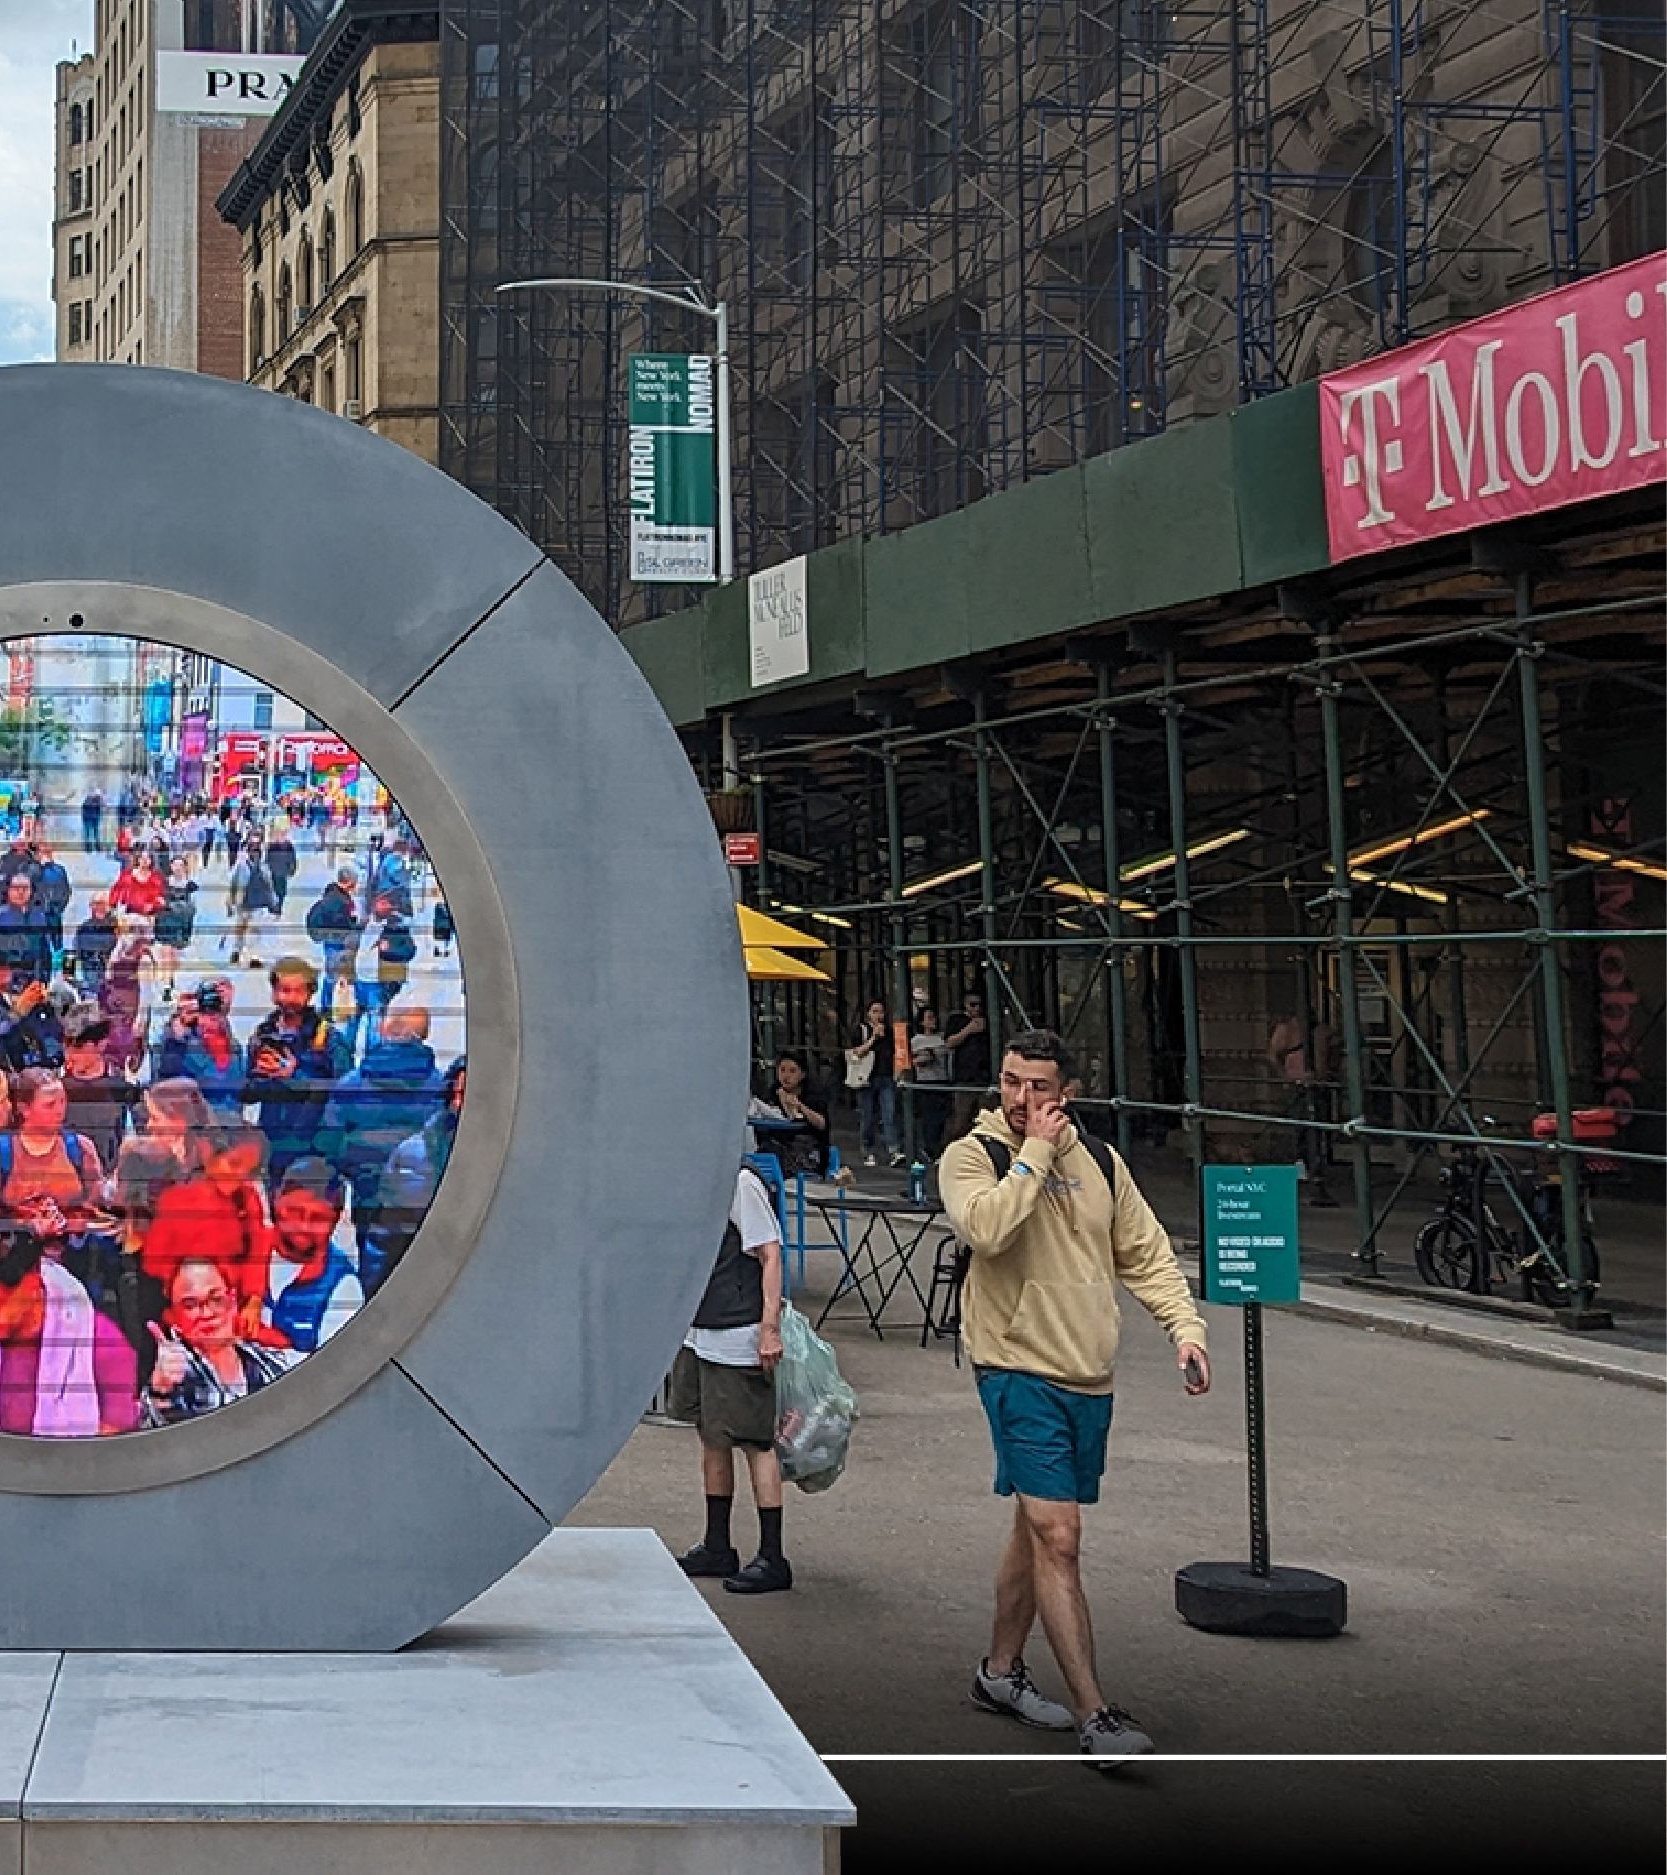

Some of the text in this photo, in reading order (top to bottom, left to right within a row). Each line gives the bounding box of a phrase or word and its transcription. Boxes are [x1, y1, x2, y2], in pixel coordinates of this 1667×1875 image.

[635, 359, 668, 370] Where
[635, 370, 683, 381] New York
[635, 391, 683, 403] New York
[688, 355, 713, 434] NOMAD
[1419, 281, 1667, 511] Mobi
[630, 425, 655, 524] FLATIRON
